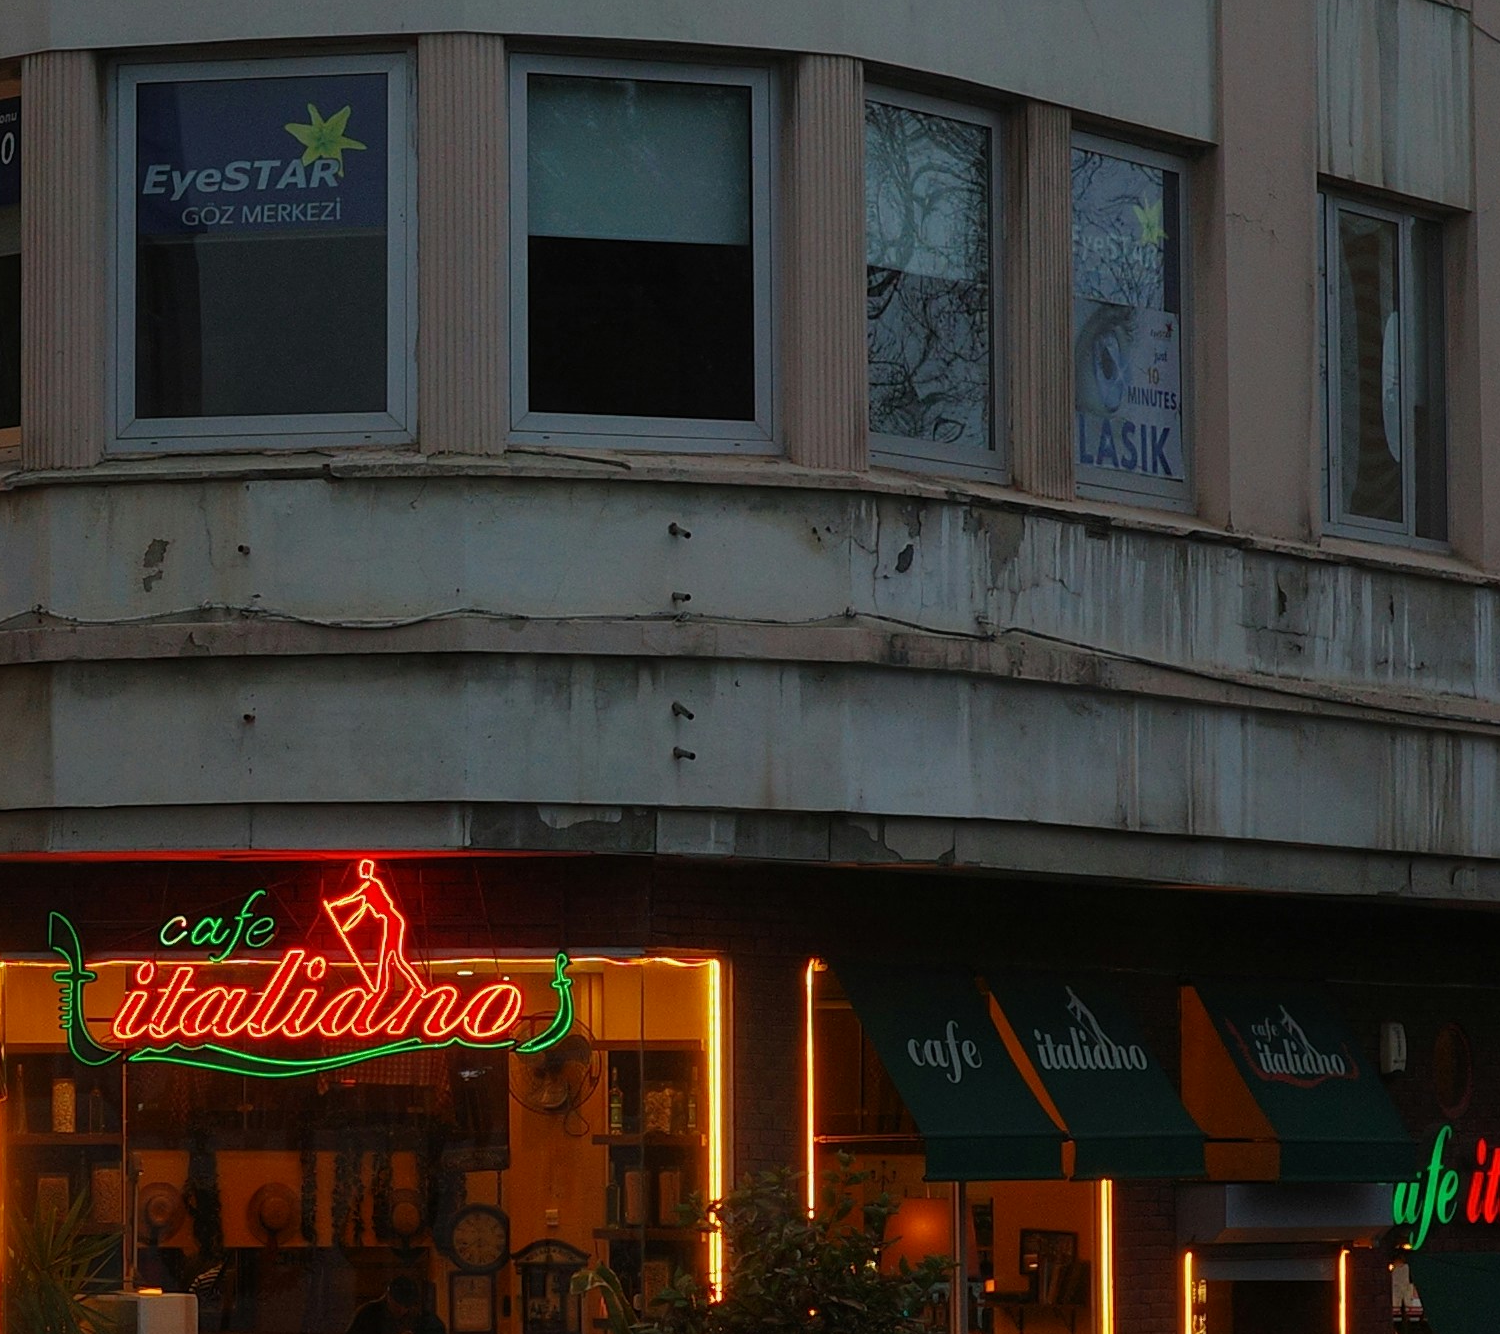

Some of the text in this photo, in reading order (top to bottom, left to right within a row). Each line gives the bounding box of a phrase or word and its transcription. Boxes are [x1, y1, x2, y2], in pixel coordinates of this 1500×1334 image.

[142, 158, 340, 202] EyeSTAR
[181, 197, 341, 226] GÖZ MERKEZİ
[1127, 384, 1177, 411] MINUTES
[1079, 416, 1172, 476] LASIK
[160, 888, 277, 963] cafe
[113, 950, 525, 1041] italiano
[907, 1020, 1148, 1084] cafe italiano
[1251, 1017, 1279, 1043] cafe
[1255, 1038, 1346, 1076] italiano
